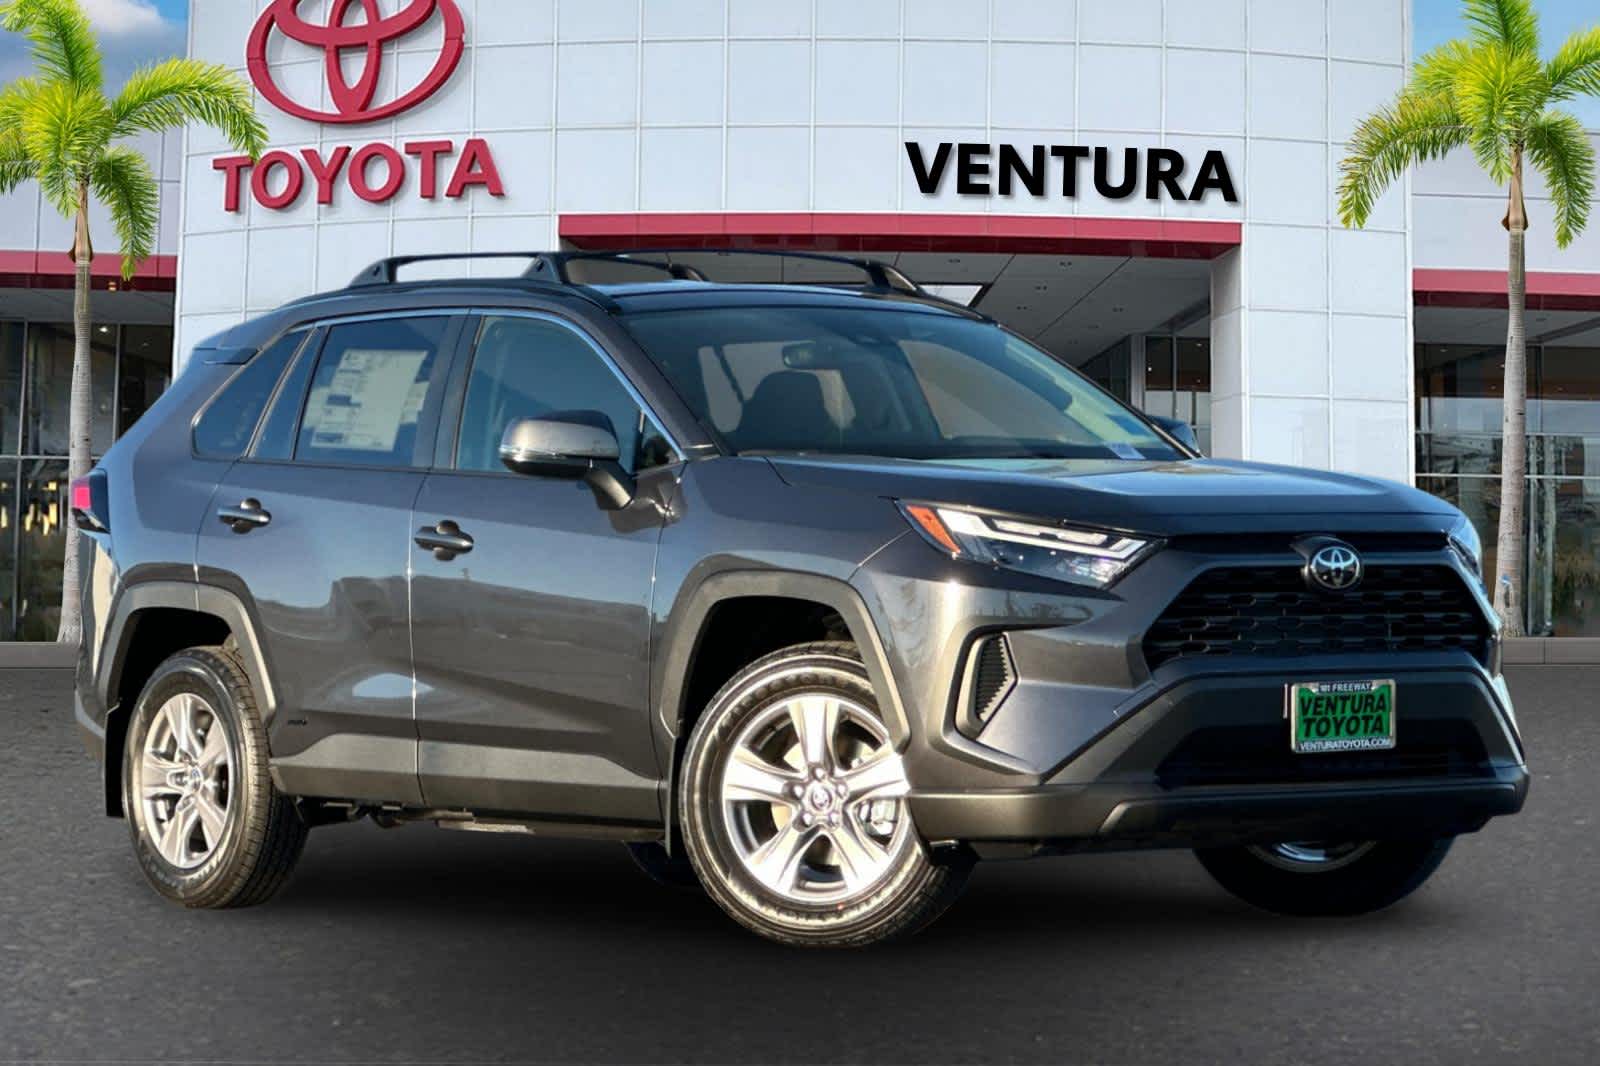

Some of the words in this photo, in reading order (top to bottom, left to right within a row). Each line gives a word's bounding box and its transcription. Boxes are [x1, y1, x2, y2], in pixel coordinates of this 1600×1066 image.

[213, 139, 504, 212] TOYOTA
[904, 142, 1240, 202] VENTURA
[1332, 682, 1372, 692] FREEWAY
[1301, 694, 1387, 716] VENTURA
[1303, 715, 1384, 738] TOYOTA
